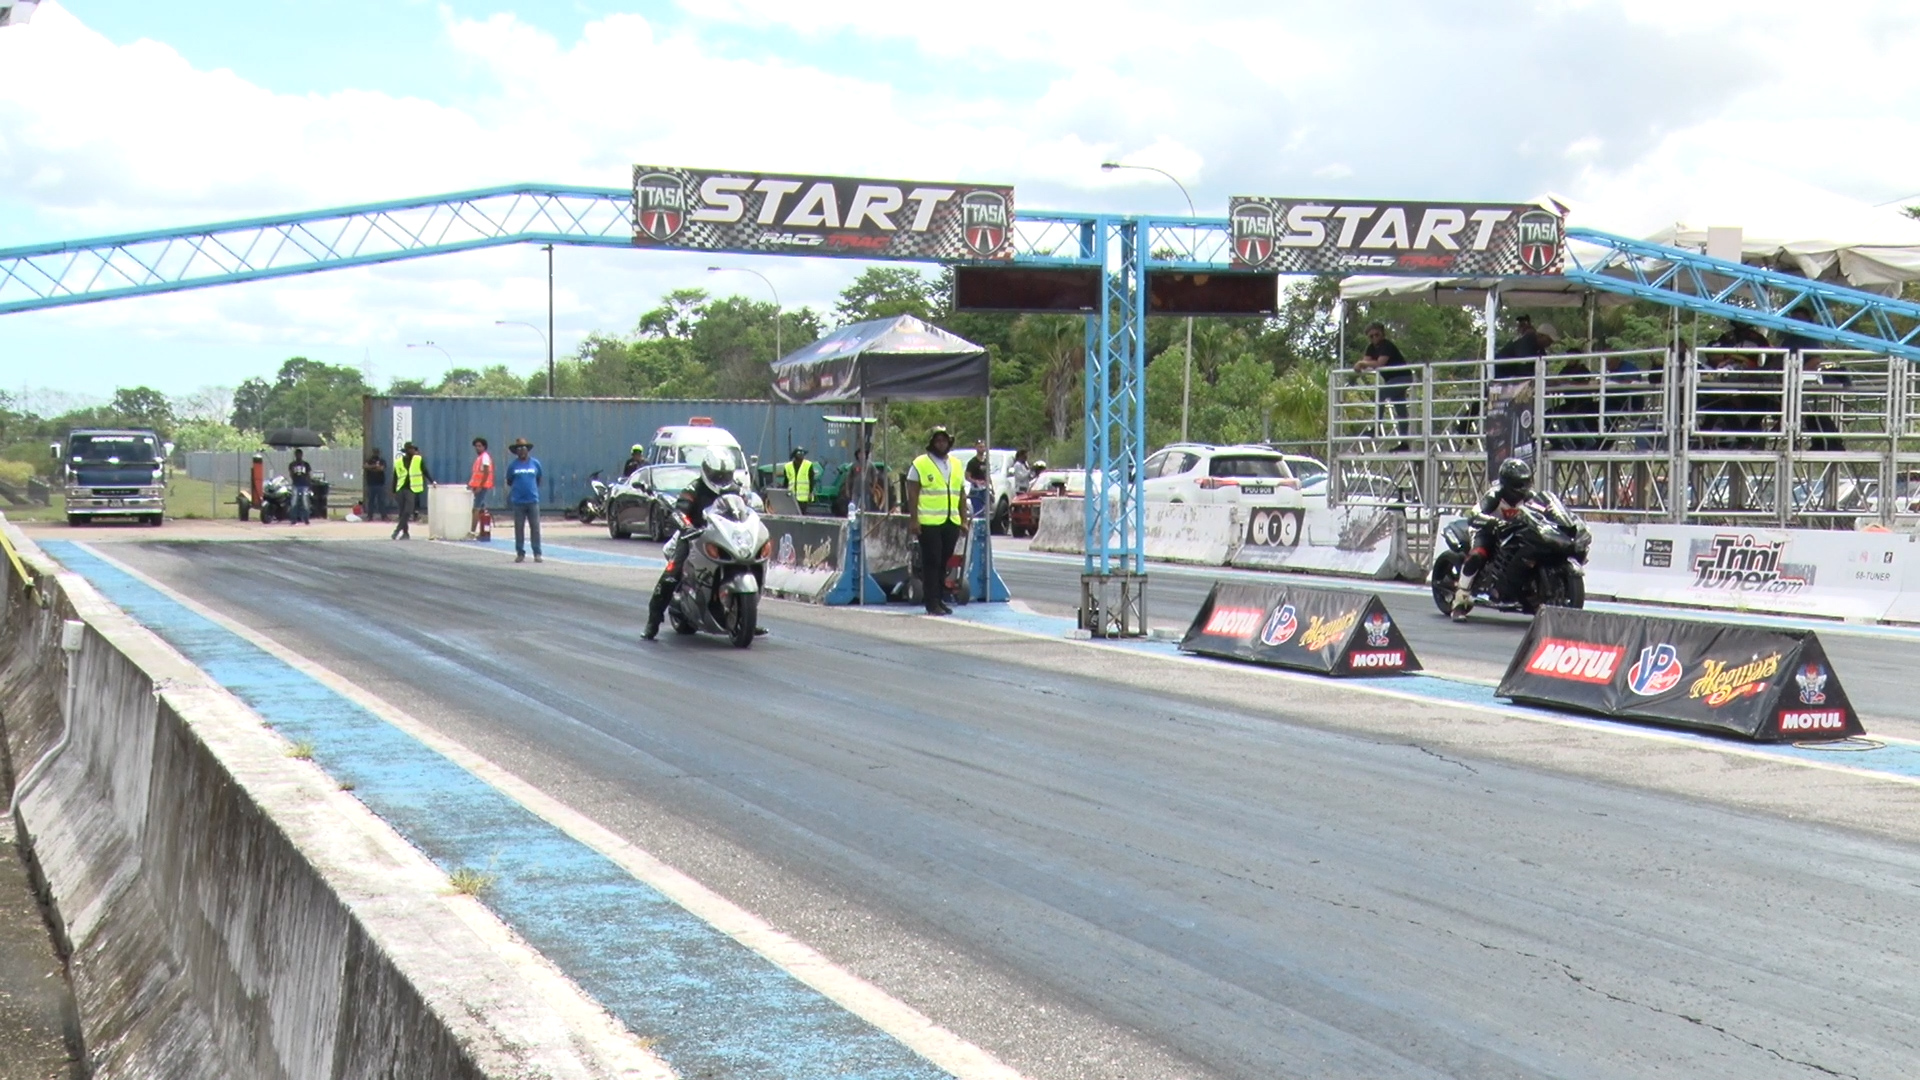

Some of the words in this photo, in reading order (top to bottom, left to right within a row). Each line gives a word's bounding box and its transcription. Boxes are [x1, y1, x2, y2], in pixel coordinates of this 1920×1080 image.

[635, 186, 686, 211] TTASA
[691, 177, 956, 232] START
[962, 203, 1008, 227] TTASA
[1232, 215, 1275, 237] TTASA
[759, 232, 824, 246] RACE
[1278, 205, 1512, 251] START
[1517, 222, 1559, 244] TTASA
[1339, 255, 1396, 267] RACE
[1713, 538, 1784, 572] Trini
[1207, 609, 1263, 634] MOTUL
[1353, 653, 1403, 667] MOTUL
[1532, 644, 1618, 680] MOTUL
[1632, 643, 1677, 693] VP
[1781, 712, 1843, 730] MOTUL
